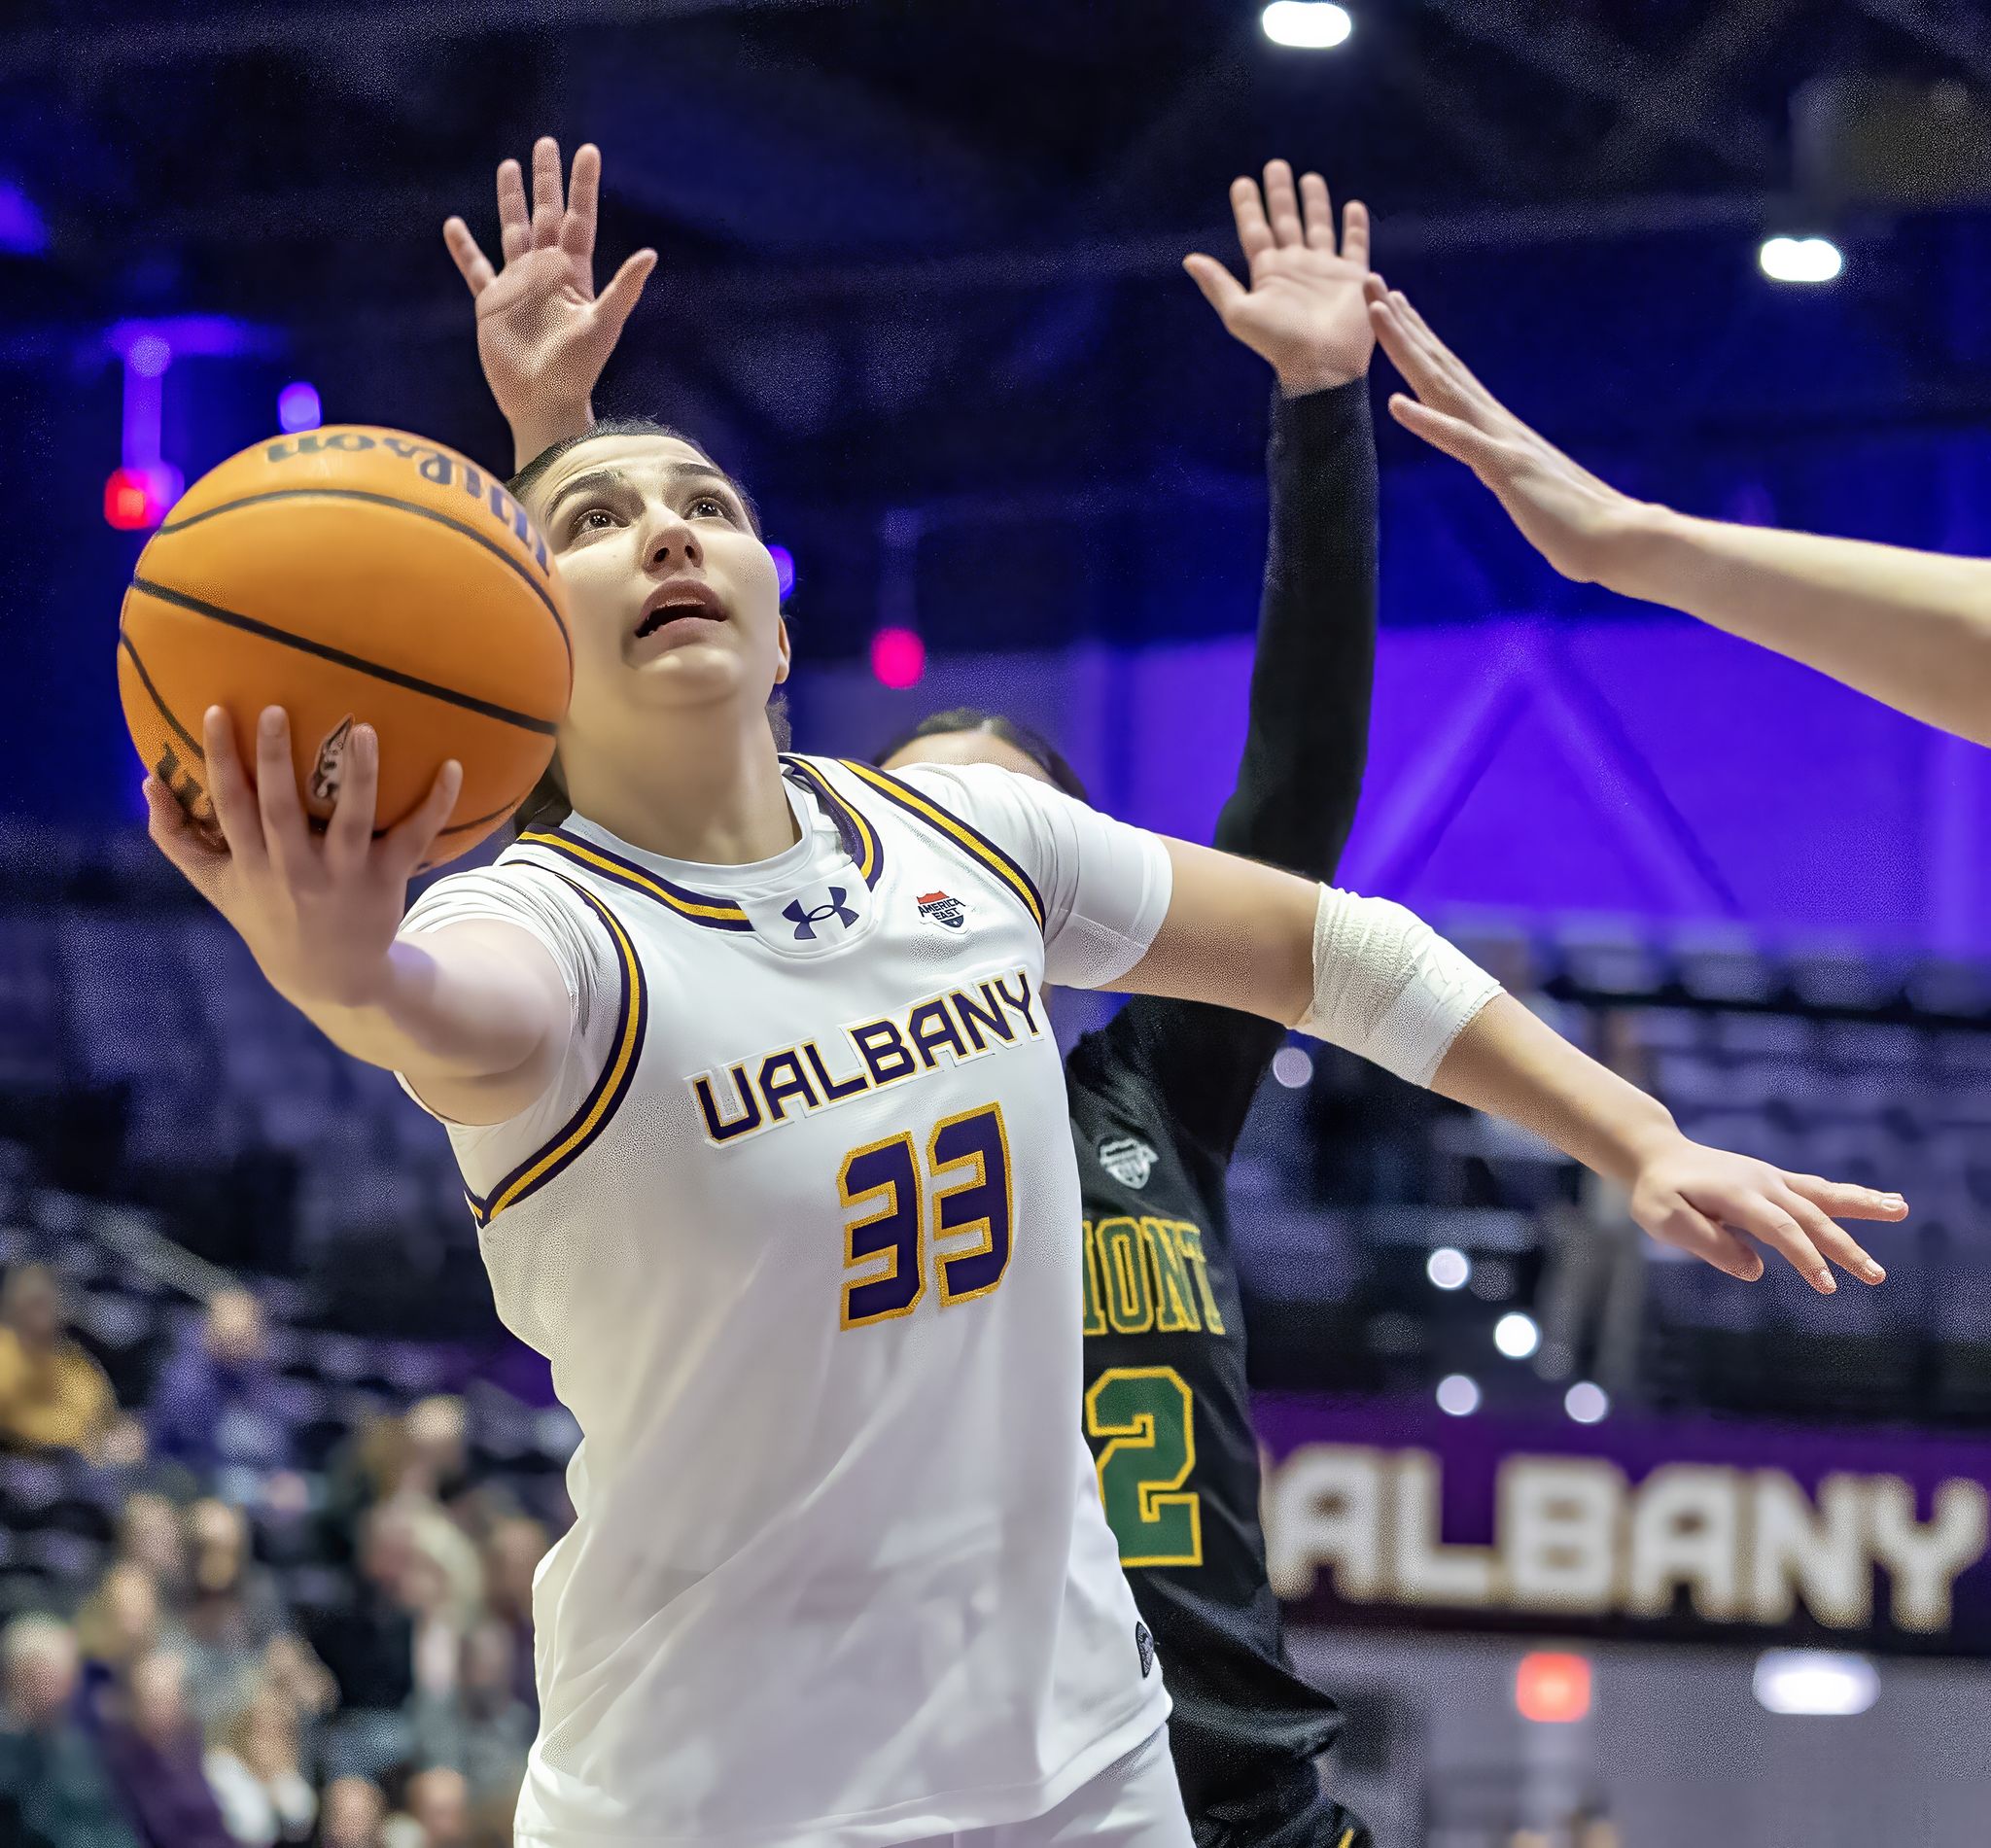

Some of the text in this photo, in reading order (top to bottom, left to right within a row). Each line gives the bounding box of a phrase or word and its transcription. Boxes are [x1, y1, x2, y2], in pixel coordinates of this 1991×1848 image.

[918, 898, 966, 918] AMERICA
[931, 907, 961, 921] EAST
[692, 971, 1041, 1144] UALBANY
[836, 1100, 1014, 1332] 33
[1085, 1367, 1204, 1567] 2
[1260, 1443, 1990, 1634] ALBANY
